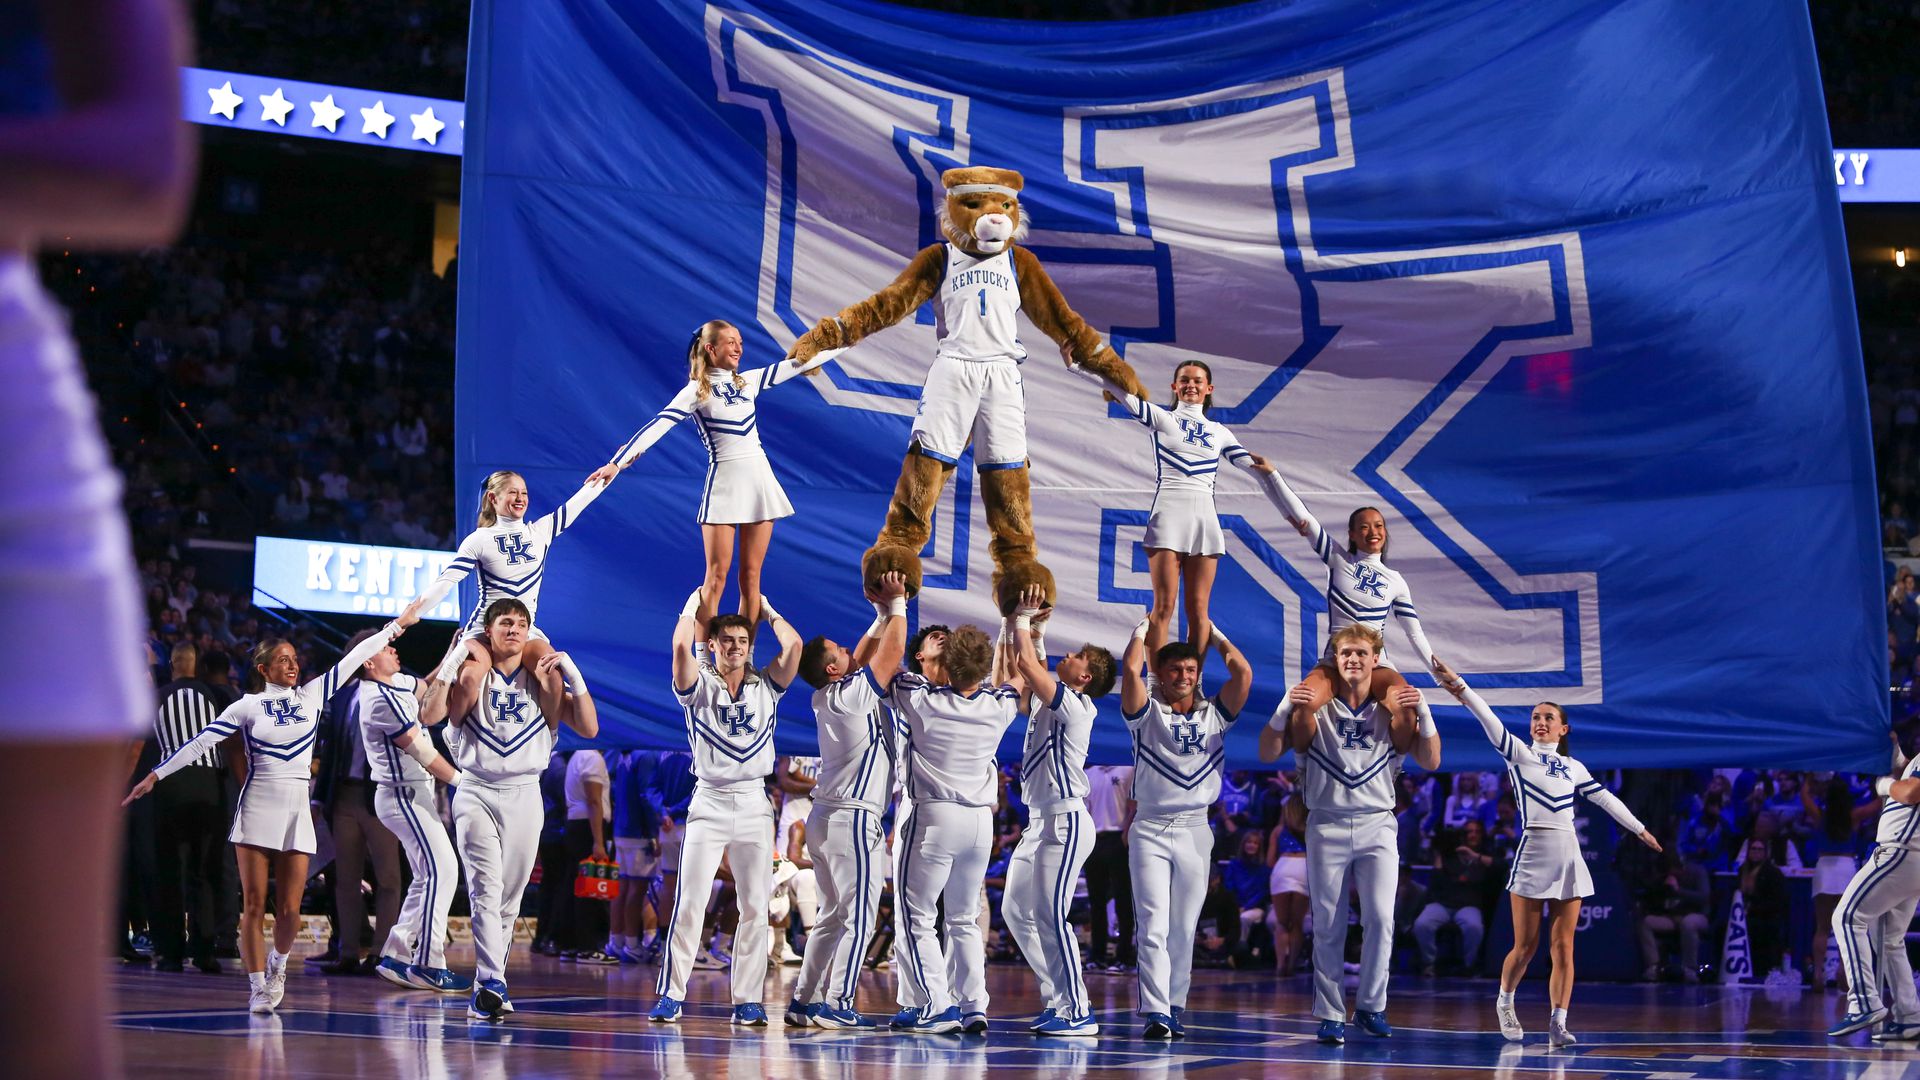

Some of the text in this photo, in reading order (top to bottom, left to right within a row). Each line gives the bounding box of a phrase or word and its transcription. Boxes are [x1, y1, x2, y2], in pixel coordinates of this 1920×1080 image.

[952, 269, 1009, 292] KENTUCKY
[977, 288, 986, 316] 1
[704, 4, 1603, 705] UK
[711, 382, 752, 407] UK
[1178, 417, 1215, 451] UK
[493, 532, 538, 566] UK
[1353, 561, 1388, 600] UK
[261, 697, 309, 726] UK
[488, 687, 529, 724] UK
[717, 702, 757, 737] UK
[1170, 722, 1207, 756] UK
[1335, 716, 1374, 751] UK
[1538, 752, 1573, 783] UK
[597, 881, 608, 893] G
[1726, 902, 1749, 975] CATS
